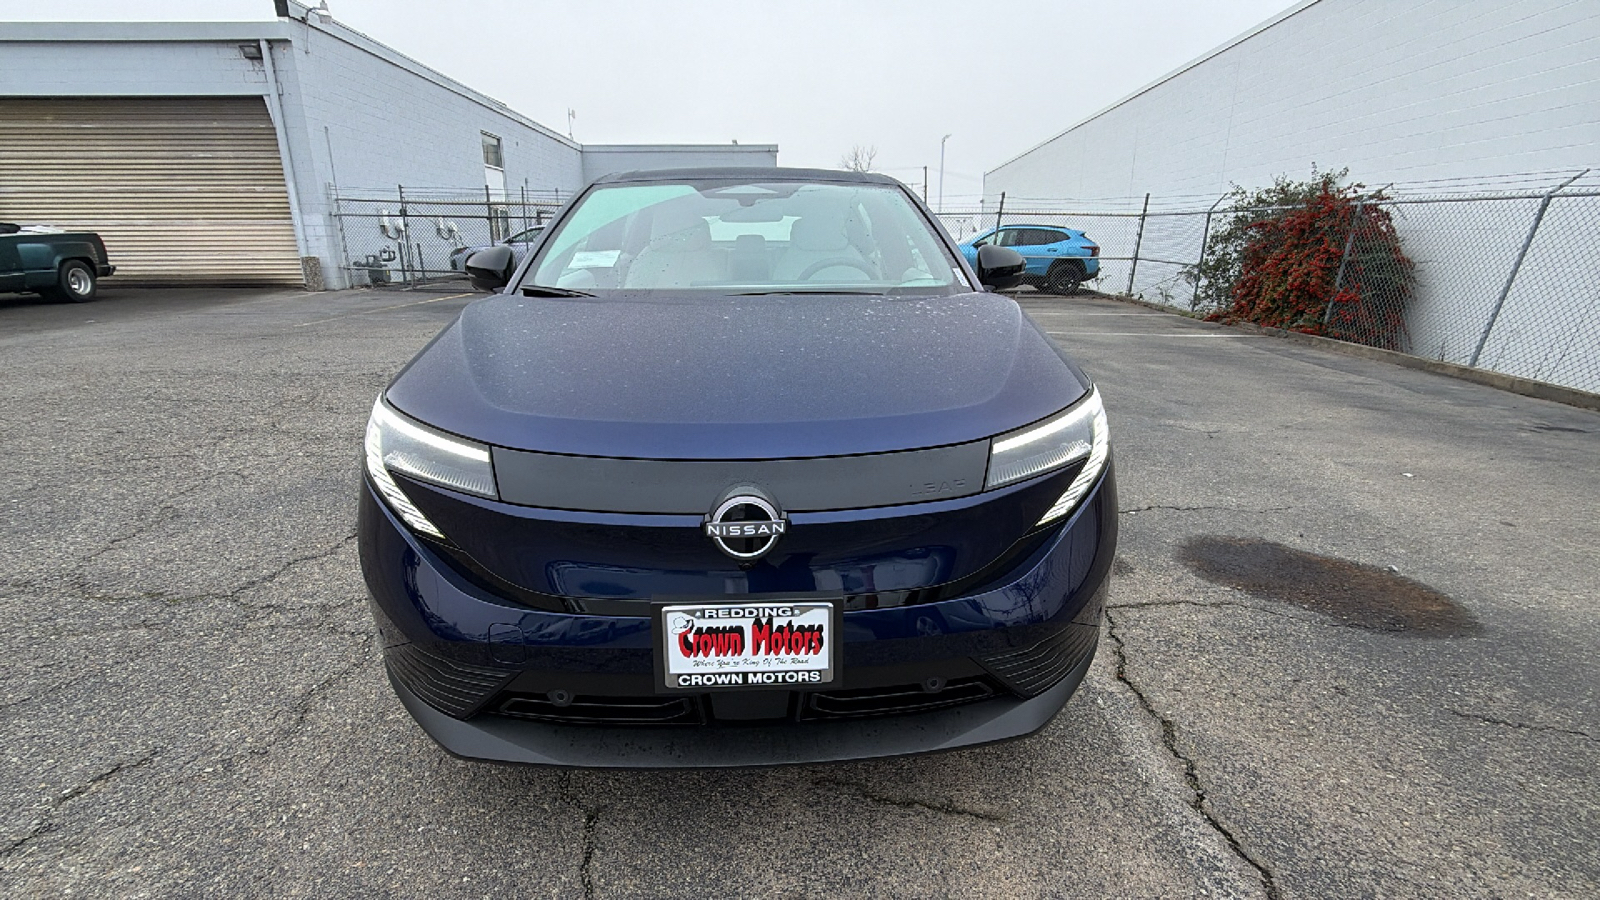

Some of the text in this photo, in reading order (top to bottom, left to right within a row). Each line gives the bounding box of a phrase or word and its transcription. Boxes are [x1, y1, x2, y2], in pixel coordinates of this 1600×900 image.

[909, 478, 966, 495] LEAF
[707, 522, 784, 536] NISSAN
[704, 607, 793, 618] REDDING
[678, 619, 824, 658] Crown Motors
[693, 657, 810, 669] Where You're King Of The Road
[678, 671, 821, 686] CROWN MOTORS
